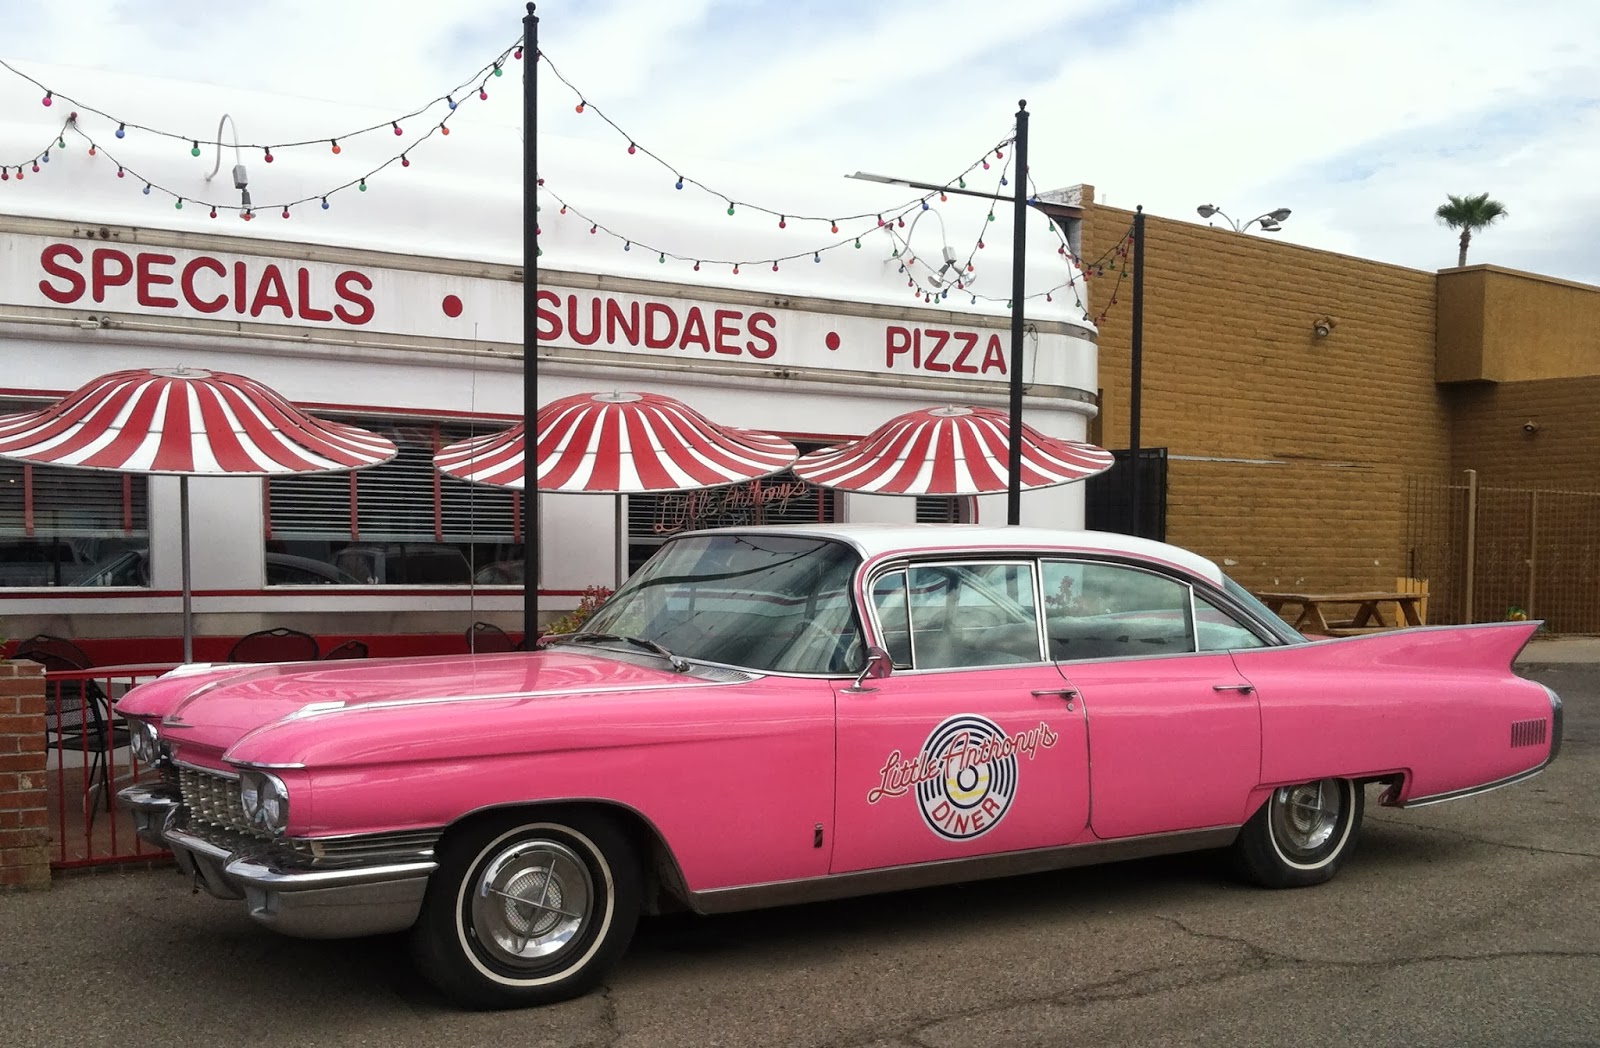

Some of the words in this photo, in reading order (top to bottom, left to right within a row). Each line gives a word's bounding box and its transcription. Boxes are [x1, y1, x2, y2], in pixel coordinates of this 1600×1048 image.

[39, 243, 375, 325] SPECIALS
[536, 290, 777, 359] SUNDAES
[886, 326, 1007, 375] PIZZA
[868, 751, 941, 804] Little
[941, 721, 1058, 780] Anthony's
[931, 797, 1000, 834] DINER
